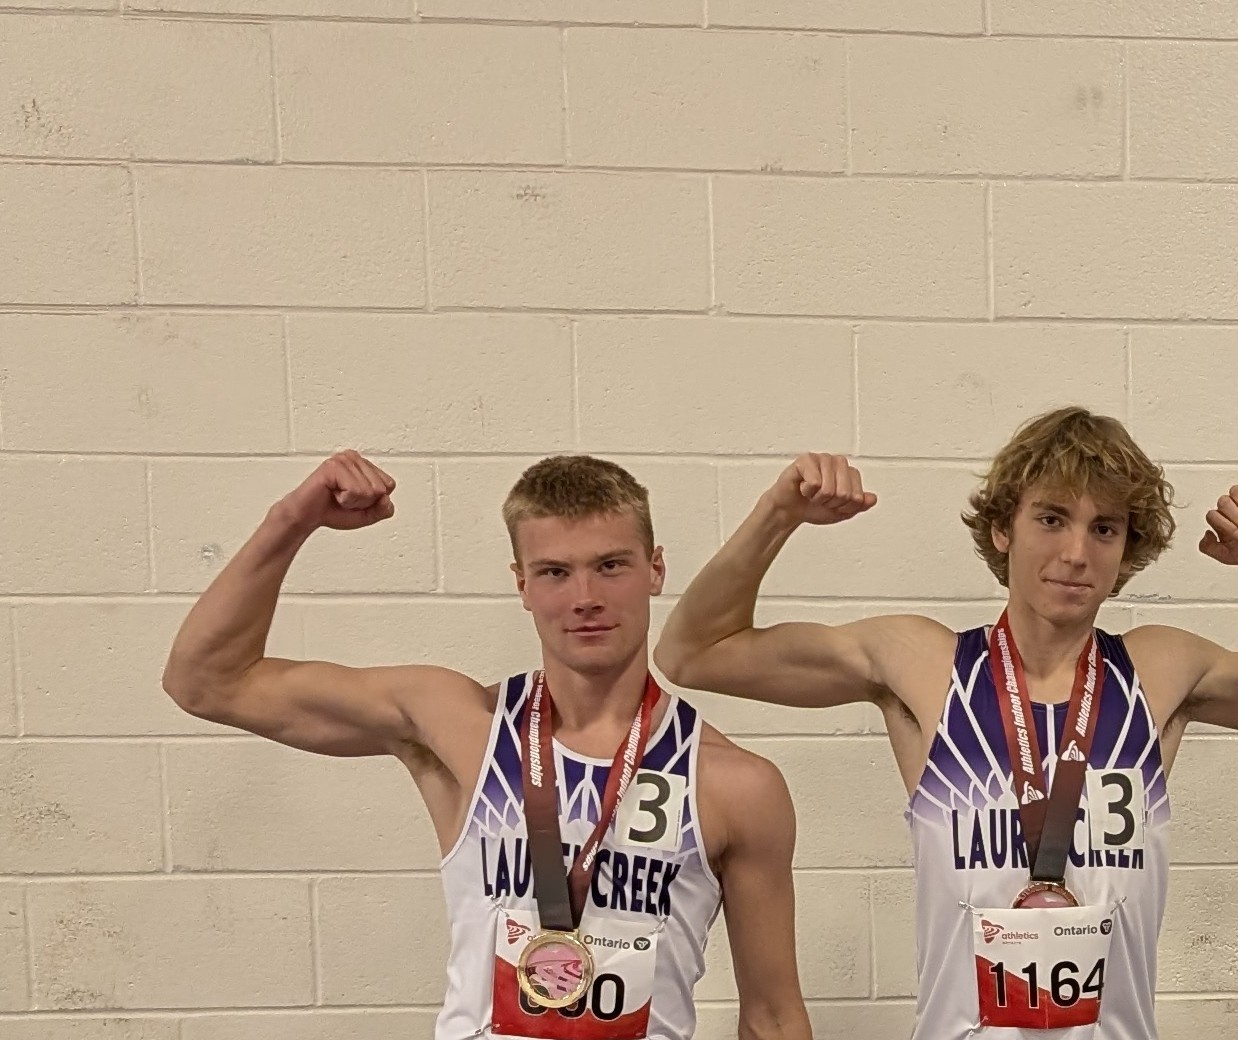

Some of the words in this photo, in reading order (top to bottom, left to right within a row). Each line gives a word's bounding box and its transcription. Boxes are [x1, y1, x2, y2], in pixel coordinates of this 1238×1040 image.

[998, 628, 1019, 694] Championships
[1010, 695, 1026, 728] Indoor
[1075, 691, 1092, 737] Athletics
[528, 711, 542, 788] Championships
[1018, 728, 1035, 775] Athletics
[617, 762, 633, 798] Indoor
[628, 773, 670, 843] 3
[1101, 772, 1135, 846] 3
[952, 808, 1029, 870] LAUR
[591, 848, 682, 917] CREEK
[584, 934, 631, 950] Ontario
[1002, 931, 1039, 940] athletics
[1054, 924, 1098, 937] Ontario
[990, 957, 1106, 1009] 1164
